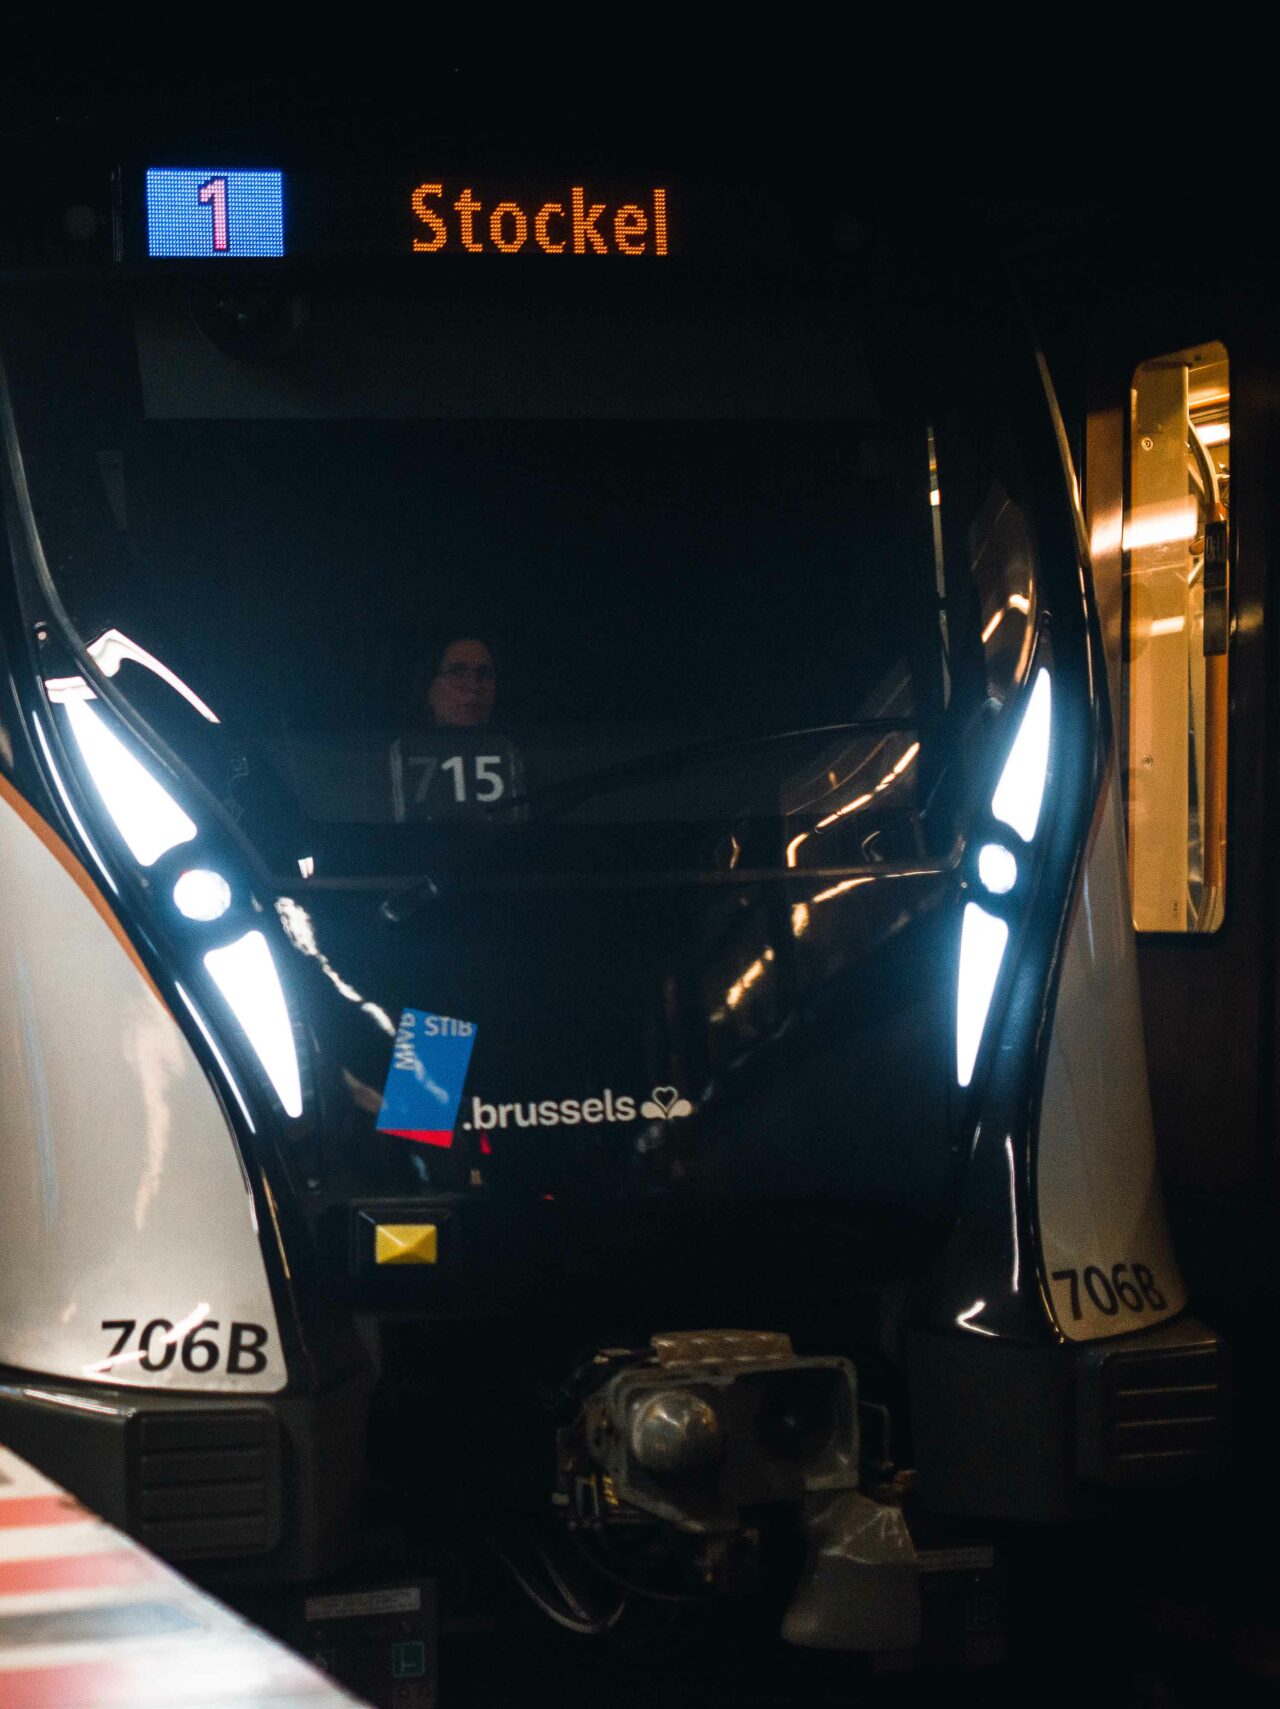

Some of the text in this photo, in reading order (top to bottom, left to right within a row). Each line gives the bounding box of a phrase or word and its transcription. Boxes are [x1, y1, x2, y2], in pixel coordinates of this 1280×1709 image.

[199, 177, 227, 251] 1
[411, 183, 668, 256] Stockel
[1052, 1263, 1168, 1321] 706B
[101, 1318, 269, 1375] 706B
